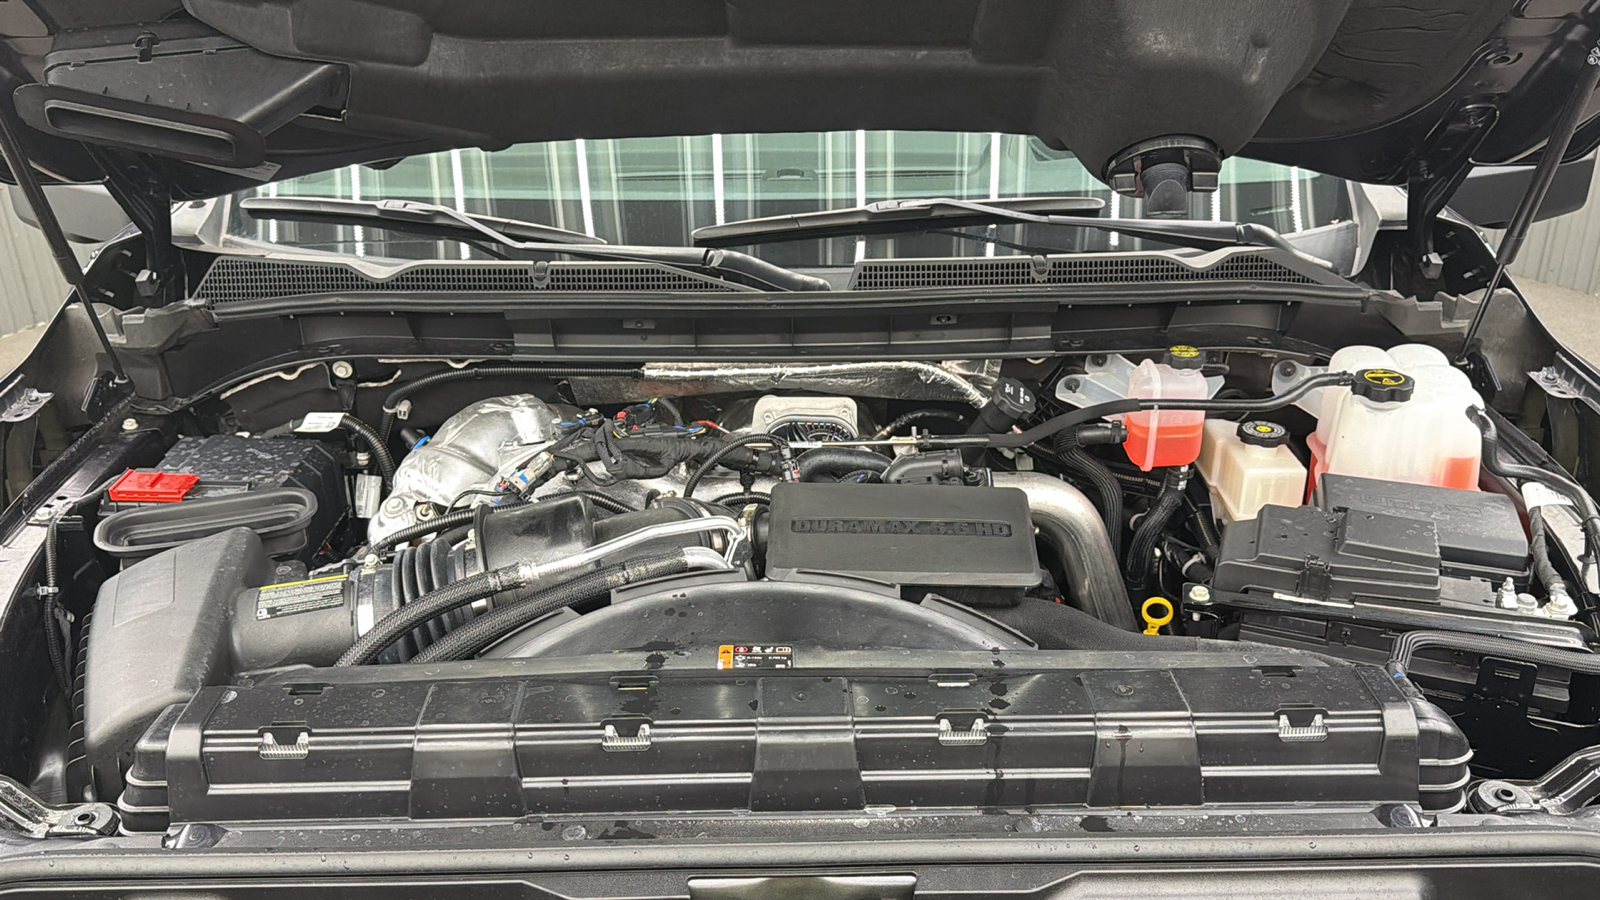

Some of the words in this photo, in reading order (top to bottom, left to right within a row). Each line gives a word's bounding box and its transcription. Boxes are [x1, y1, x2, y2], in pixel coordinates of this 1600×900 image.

[793, 519, 920, 534] DURAMAX
[930, 521, 970, 535] 6.6
[975, 522, 1011, 537] HD
